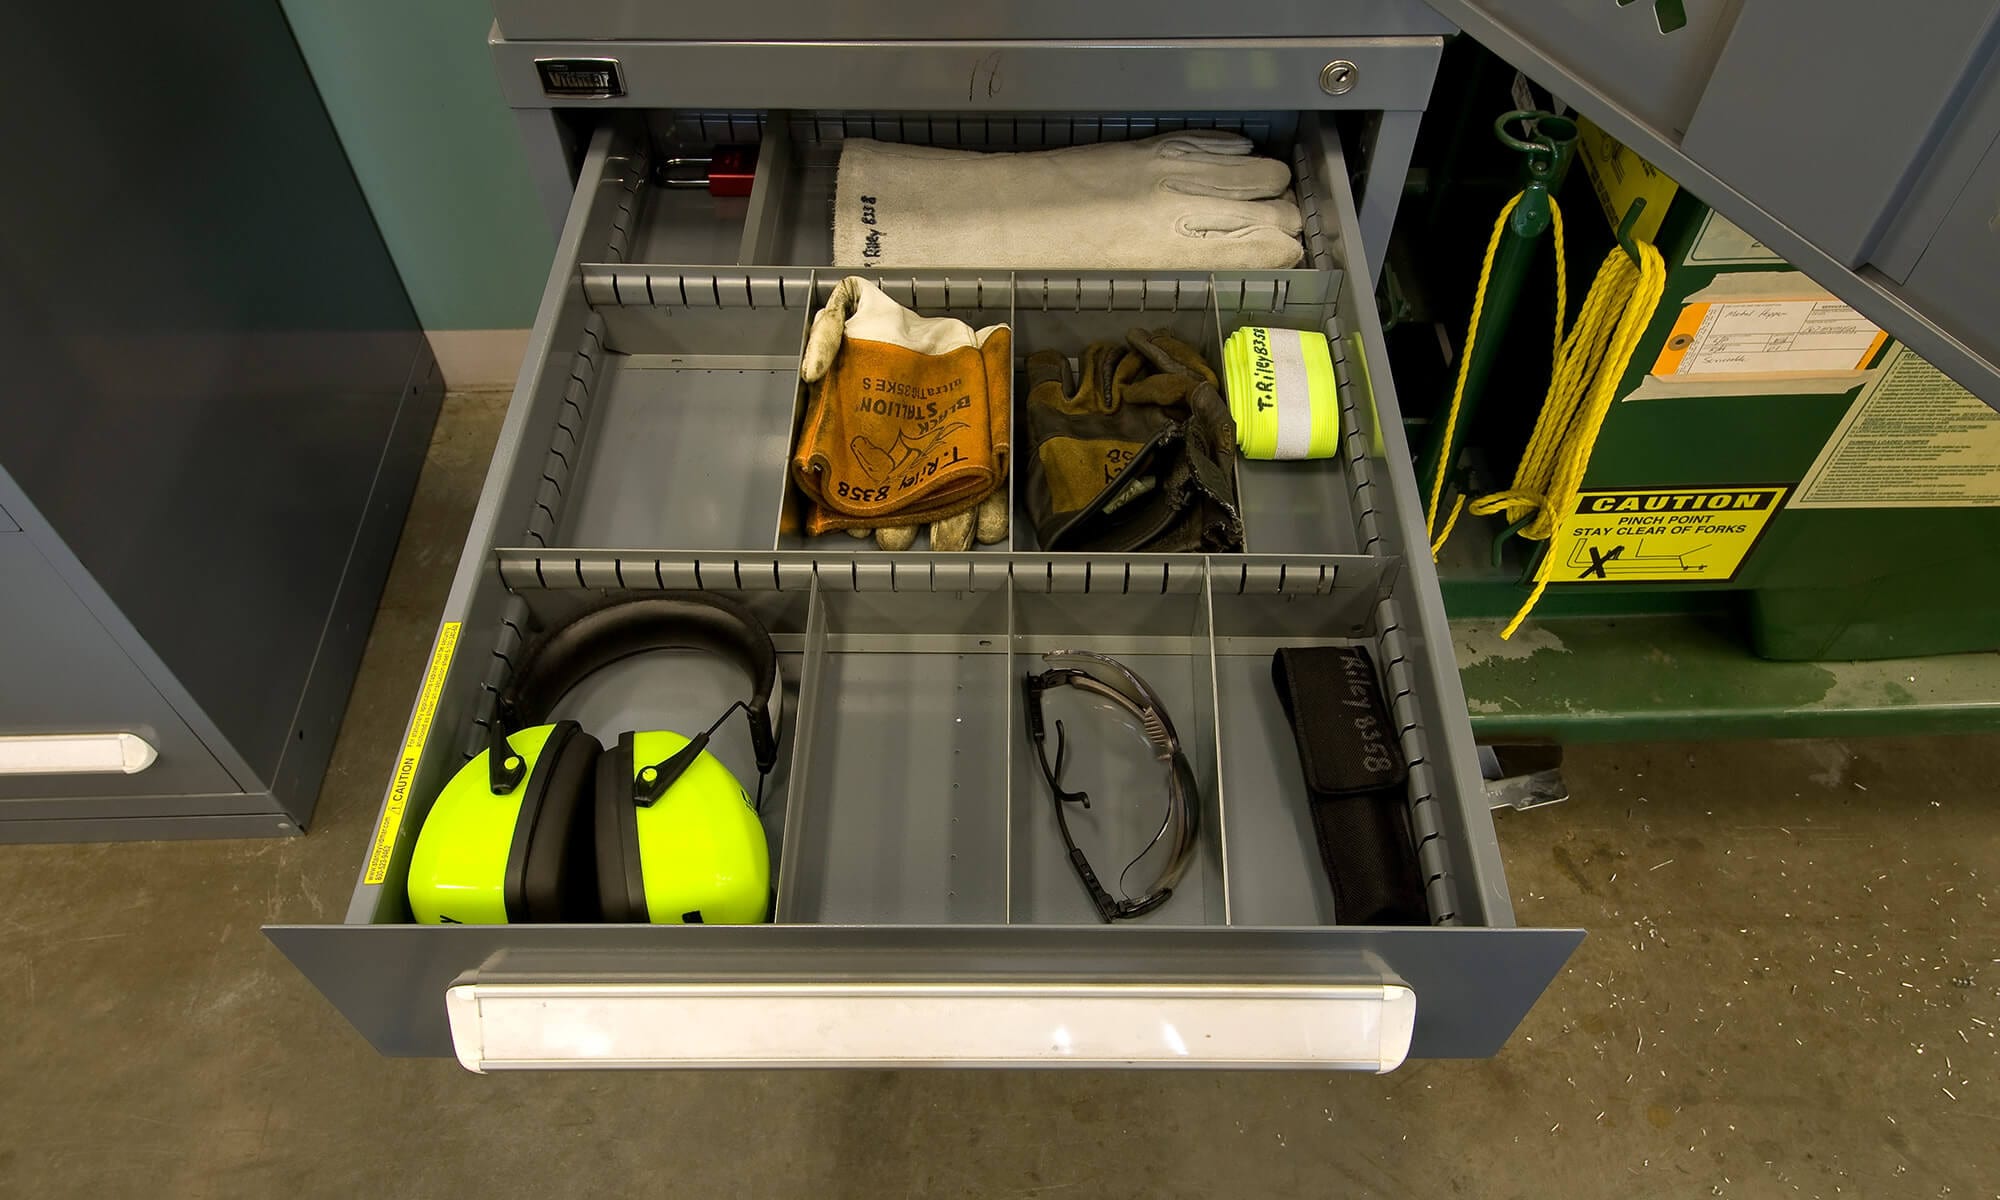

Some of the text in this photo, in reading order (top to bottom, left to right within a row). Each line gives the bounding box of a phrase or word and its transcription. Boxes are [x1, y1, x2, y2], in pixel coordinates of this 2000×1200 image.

[860, 397, 938, 420] STALLION
[917, 395, 971, 436] BLACK
[837, 481, 890, 502] 8358
[1591, 494, 1762, 512] CAUTION
[1573, 524, 1747, 537] STAY CLEAR OF FORKS
[1618, 515, 1715, 525] PINCH POINT
[393, 757, 415, 802] CAUTION
